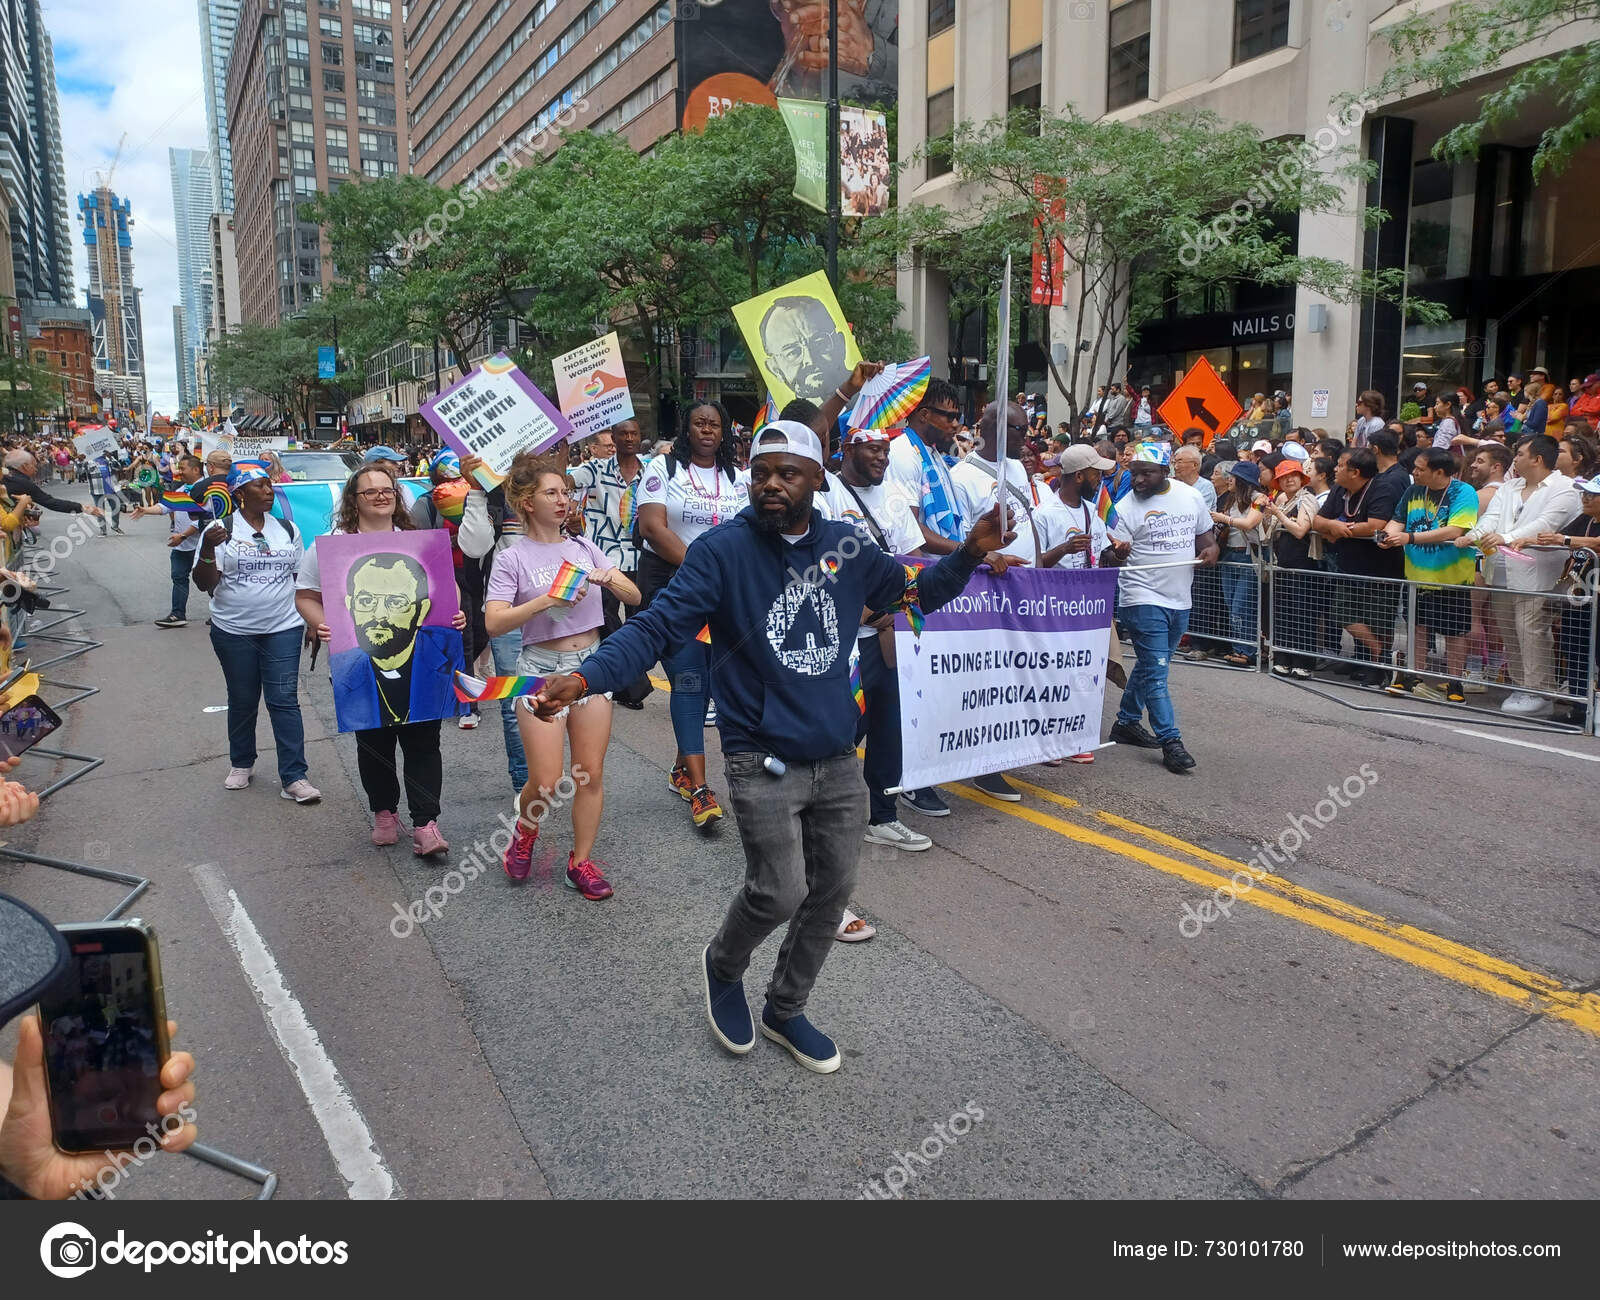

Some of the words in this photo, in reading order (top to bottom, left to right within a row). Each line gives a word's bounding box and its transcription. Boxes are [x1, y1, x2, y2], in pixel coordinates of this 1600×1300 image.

[1232, 316, 1280, 337] NAILS
[563, 348, 585, 362] LET'S
[585, 339, 607, 352] LOVE
[563, 356, 589, 372] THOSE
[590, 347, 611, 360] WHO
[568, 359, 606, 379] WORSHIP
[438, 384, 477, 416] WE'RE
[448, 389, 498, 428] COMING
[568, 409, 585, 421] AND
[587, 391, 625, 412] WORSHIP
[392, 413, 405, 421] 40
[458, 417, 484, 440] OUT
[483, 395, 517, 422] WITH
[517, 422, 532, 434] LET'S
[532, 413, 545, 424] END
[573, 414, 600, 428] THOSE
[602, 403, 623, 416] WHO
[589, 418, 611, 432] LOVE
[469, 422, 506, 452] FAITH
[500, 421, 548, 457] RELIGIOUS-BASED
[233, 449, 260, 457] ALLIAN
[683, 497, 718, 512] Faith
[1149, 513, 1195, 529] Rainbow
[1150, 526, 1178, 541] Faith
[237, 558, 272, 571] Faith
[531, 570, 553, 589] LAS
[1017, 594, 1047, 617] and
[1050, 594, 1106, 617] Freedom
[930, 650, 982, 675] ENDING
[1038, 684, 1071, 703] AND
[1022, 713, 1086, 737] TOGETHER
